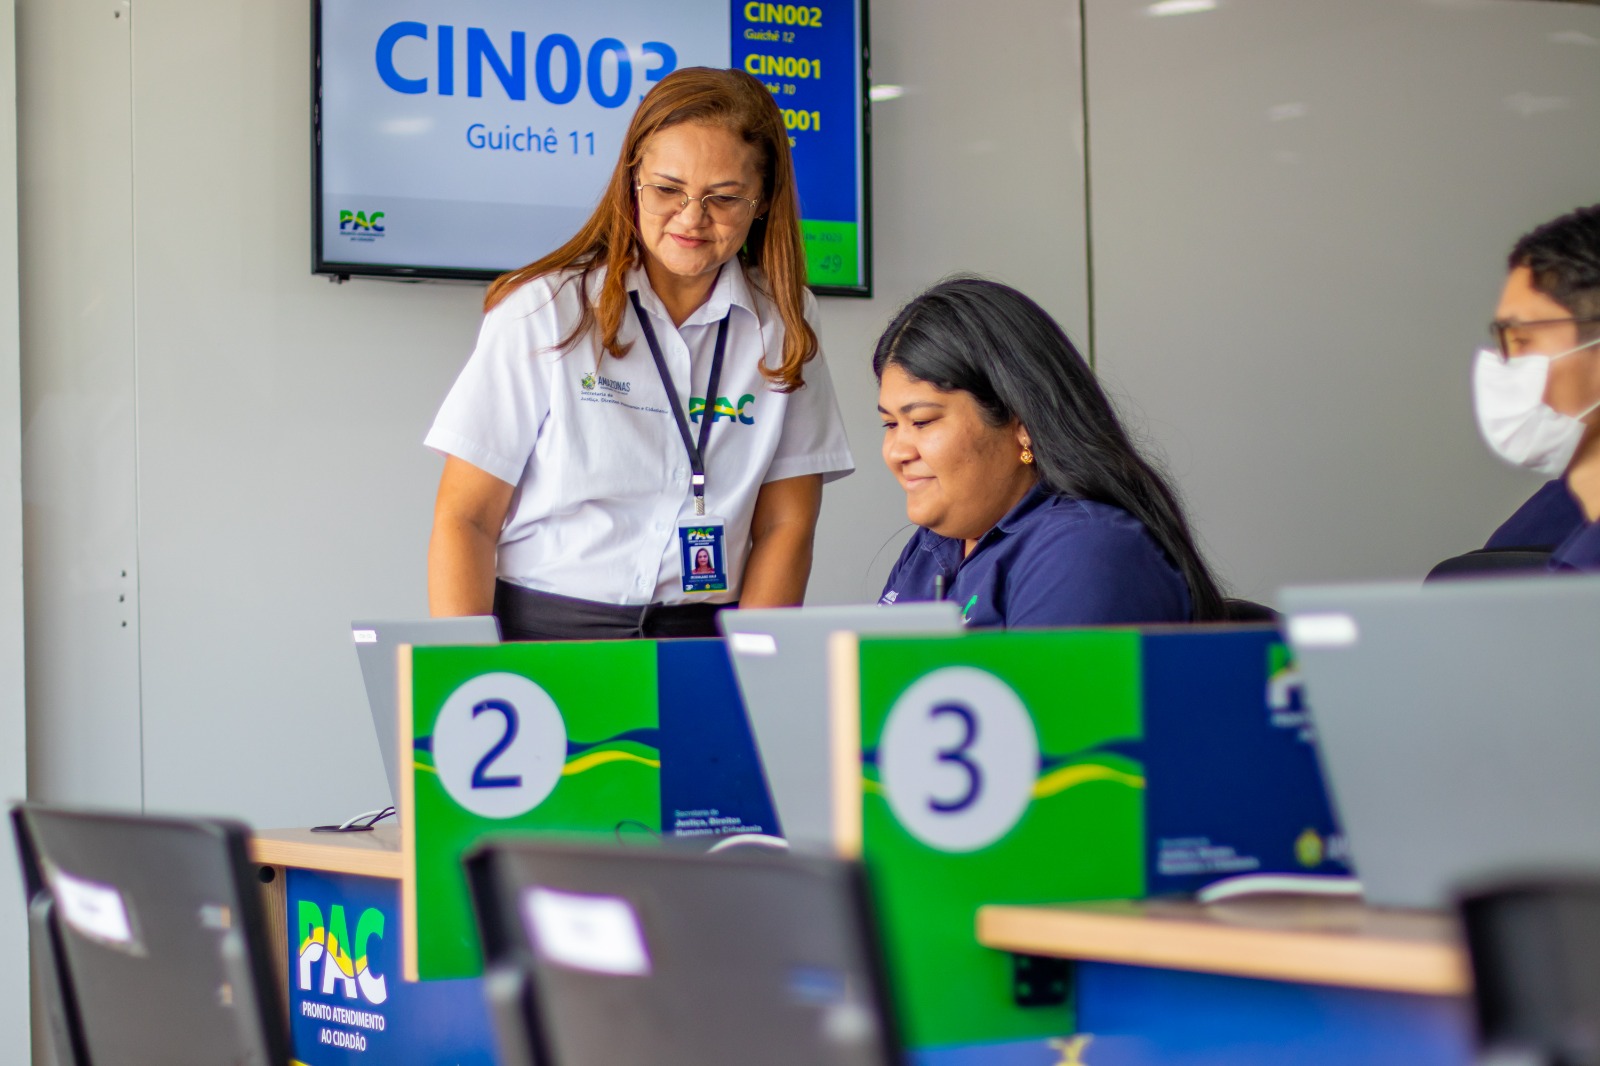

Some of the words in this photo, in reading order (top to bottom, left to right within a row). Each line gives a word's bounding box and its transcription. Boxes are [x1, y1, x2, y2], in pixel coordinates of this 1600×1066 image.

[744, 1, 822, 27] CIN002
[744, 28, 779, 42] Guichê
[375, 21, 678, 108] CIN003
[744, 54, 821, 79] CIN001
[466, 123, 558, 153] Guichê
[569, 130, 594, 155] 11
[340, 209, 385, 232] PAC
[598, 376, 631, 392] AMAZONAS
[689, 393, 755, 425] PAC
[688, 527, 715, 540] PAC
[470, 698, 523, 790] 2
[927, 700, 985, 815] 3
[298, 900, 387, 1004] PAC
[302, 1001, 332, 1021] PRONTO
[332, 1006, 385, 1031] ATENDIMENTO
[321, 1028, 332, 1044] AO
[333, 1031, 366, 1051] CIDADÃO
